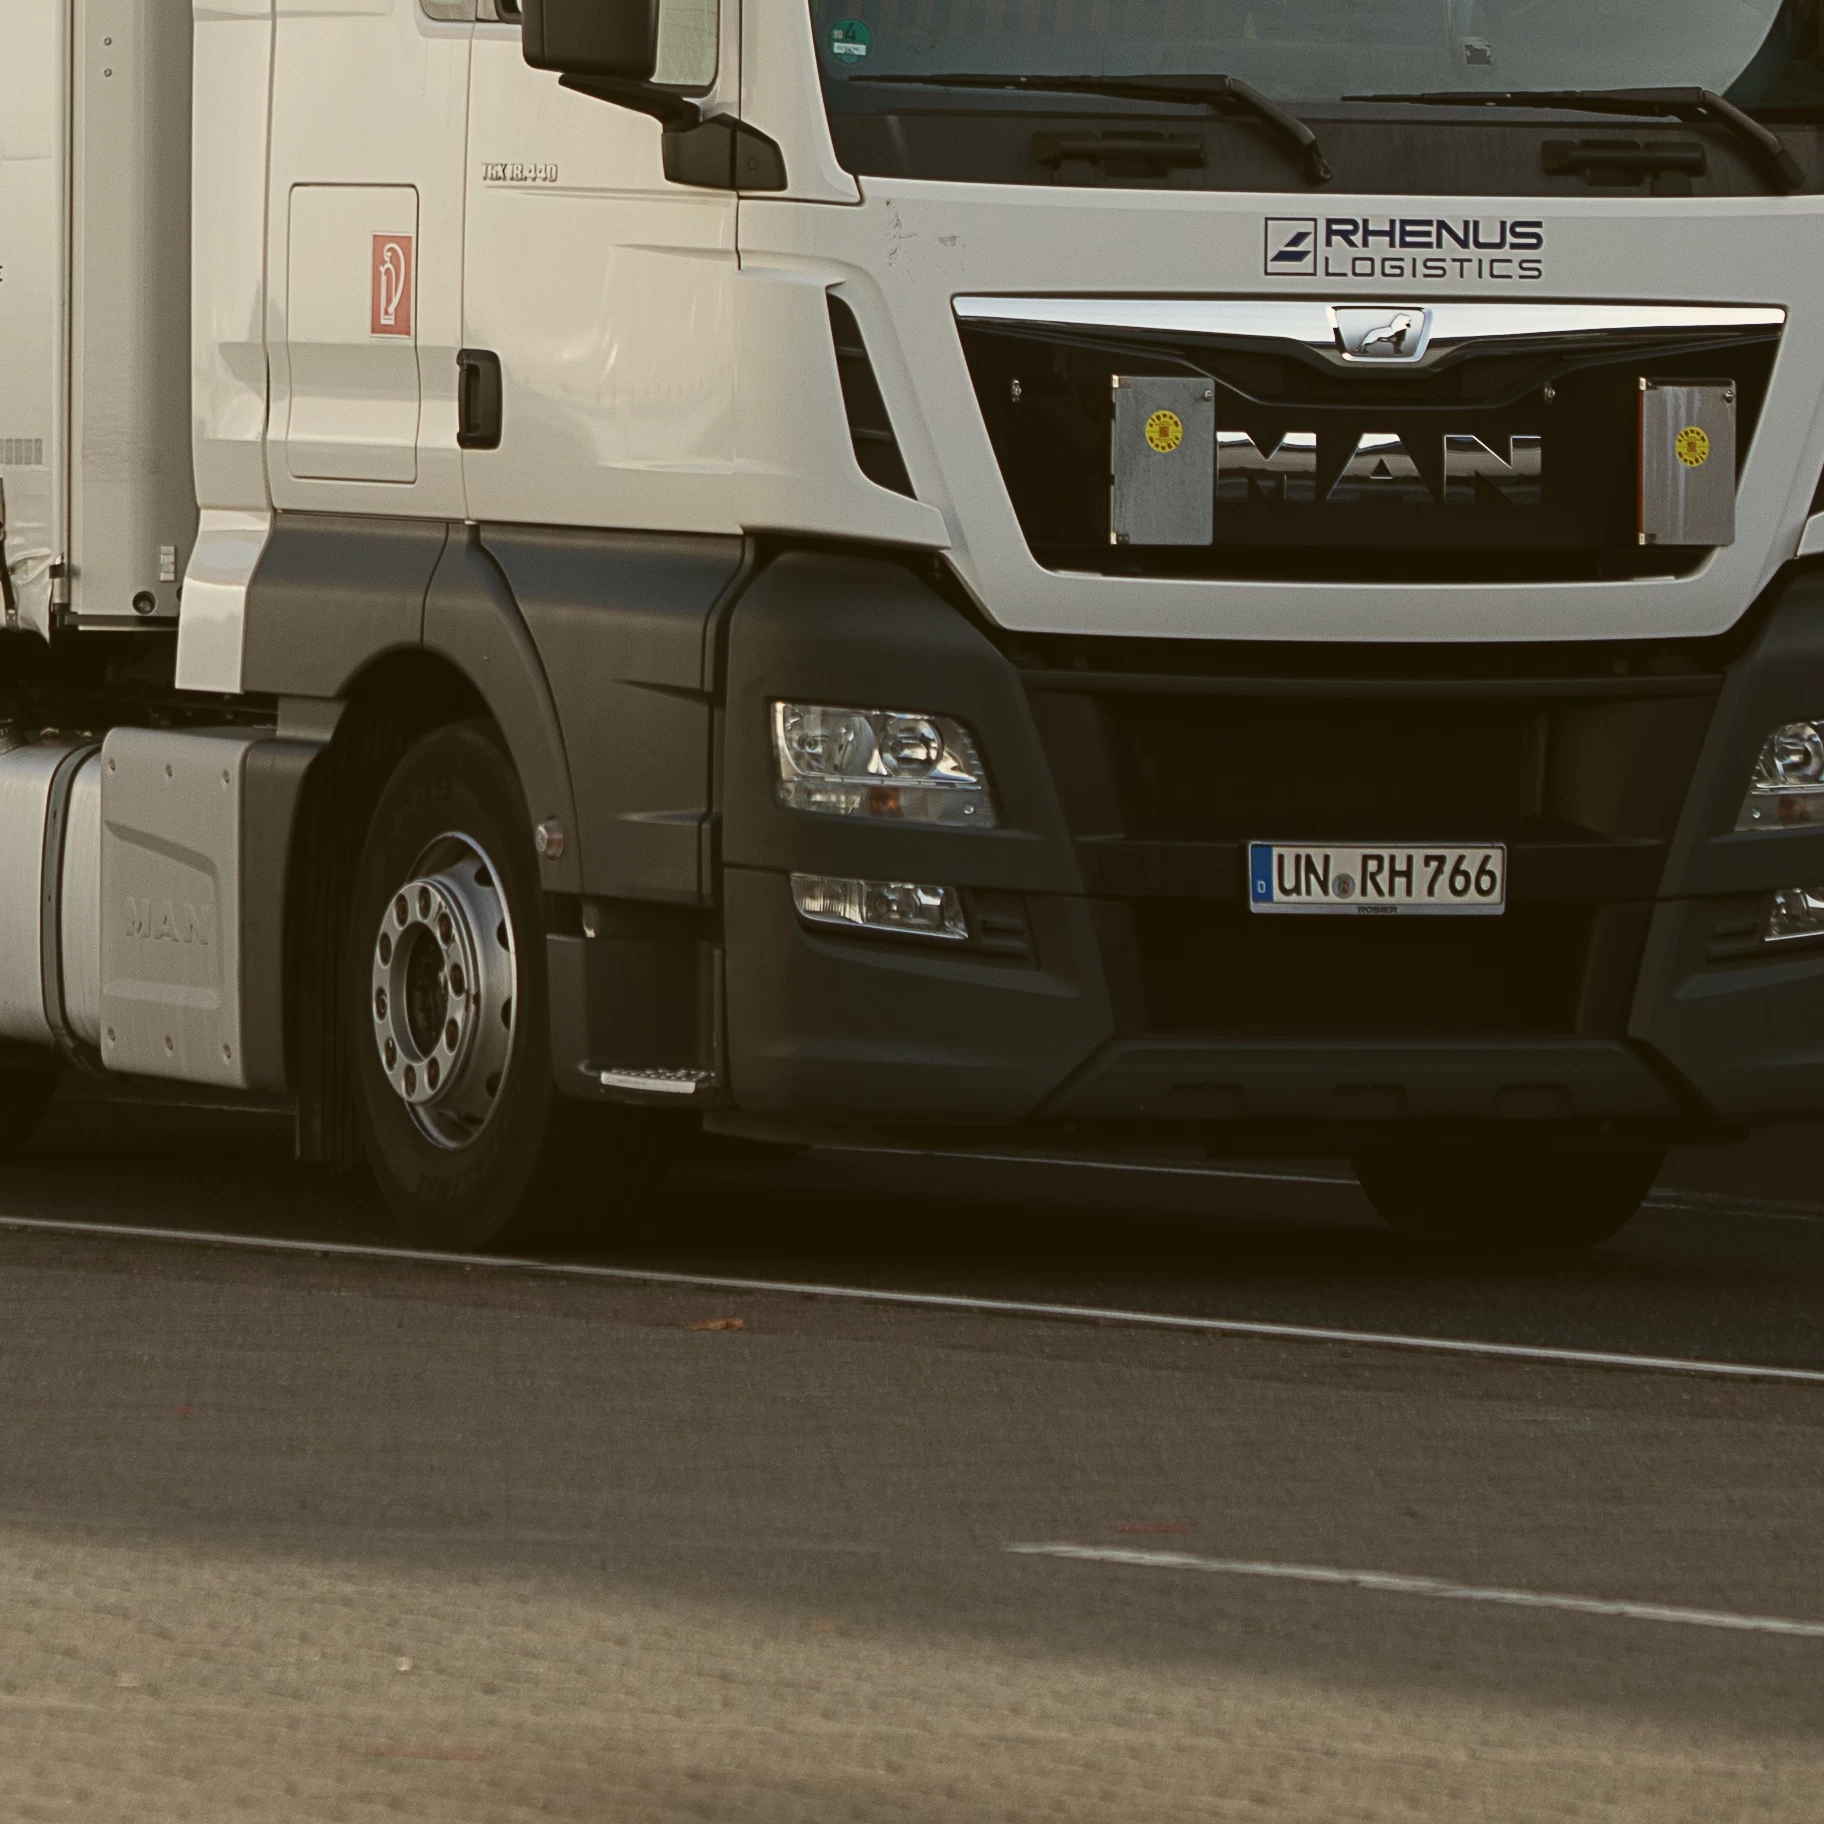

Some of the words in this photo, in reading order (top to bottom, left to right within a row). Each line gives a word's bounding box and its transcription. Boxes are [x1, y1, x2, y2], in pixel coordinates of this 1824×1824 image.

[845, 21, 857, 41] 4
[1324, 217, 1544, 251] RHENUS
[1324, 255, 1543, 280] LOGISTICS
[1215, 430, 1543, 504] MAN
[1277, 853, 1331, 897] UN
